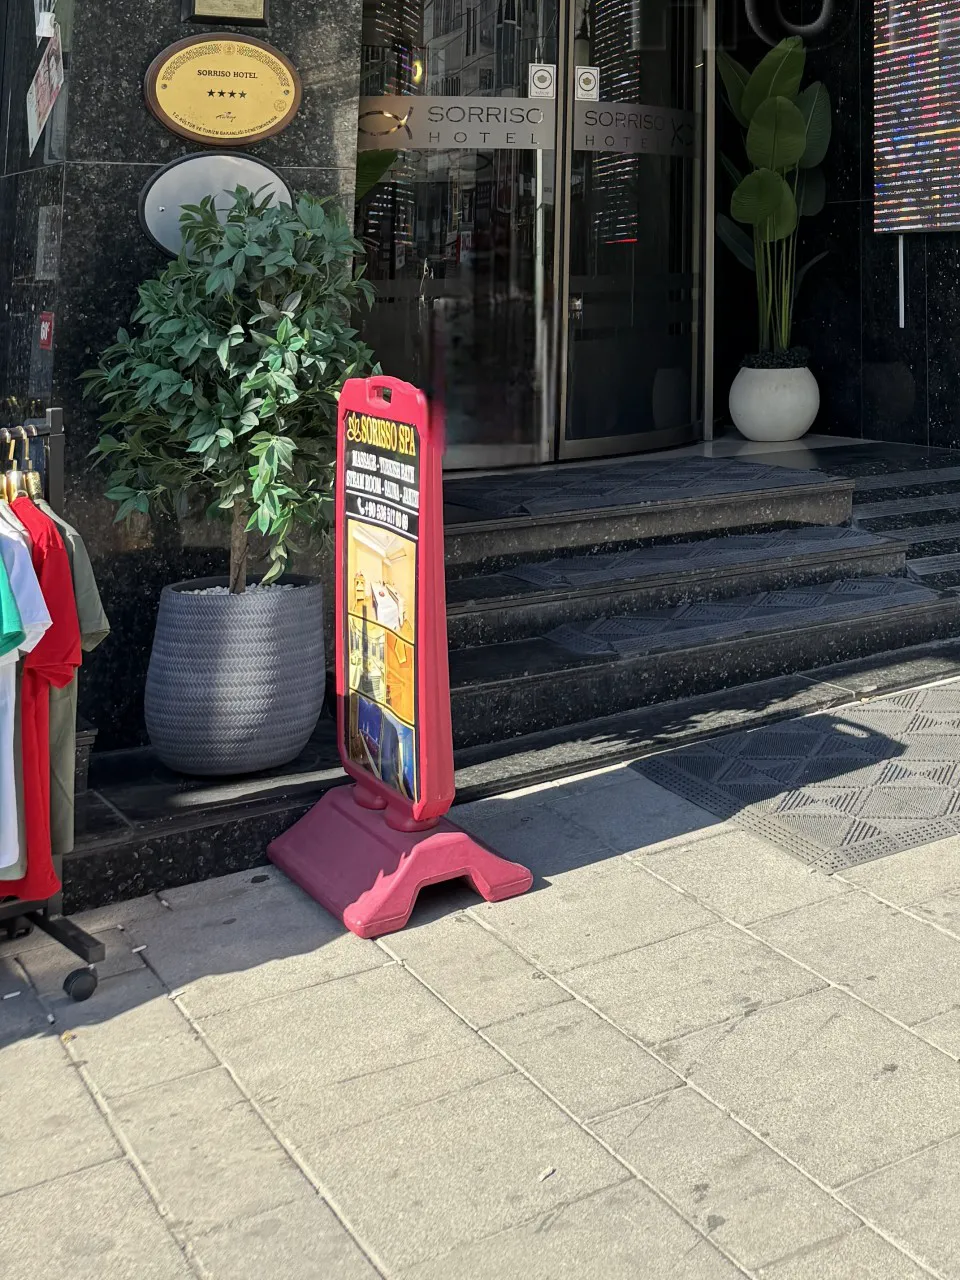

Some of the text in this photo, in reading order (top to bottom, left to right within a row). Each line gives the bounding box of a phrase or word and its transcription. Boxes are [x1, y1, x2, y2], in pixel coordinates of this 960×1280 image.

[197, 68, 258, 80] SORRISO HOTEL
[427, 105, 545, 125] SORRISO
[584, 109, 666, 131] SORRISO
[428, 131, 540, 145] HOTEL
[361, 414, 417, 457] SORISSO SPA
